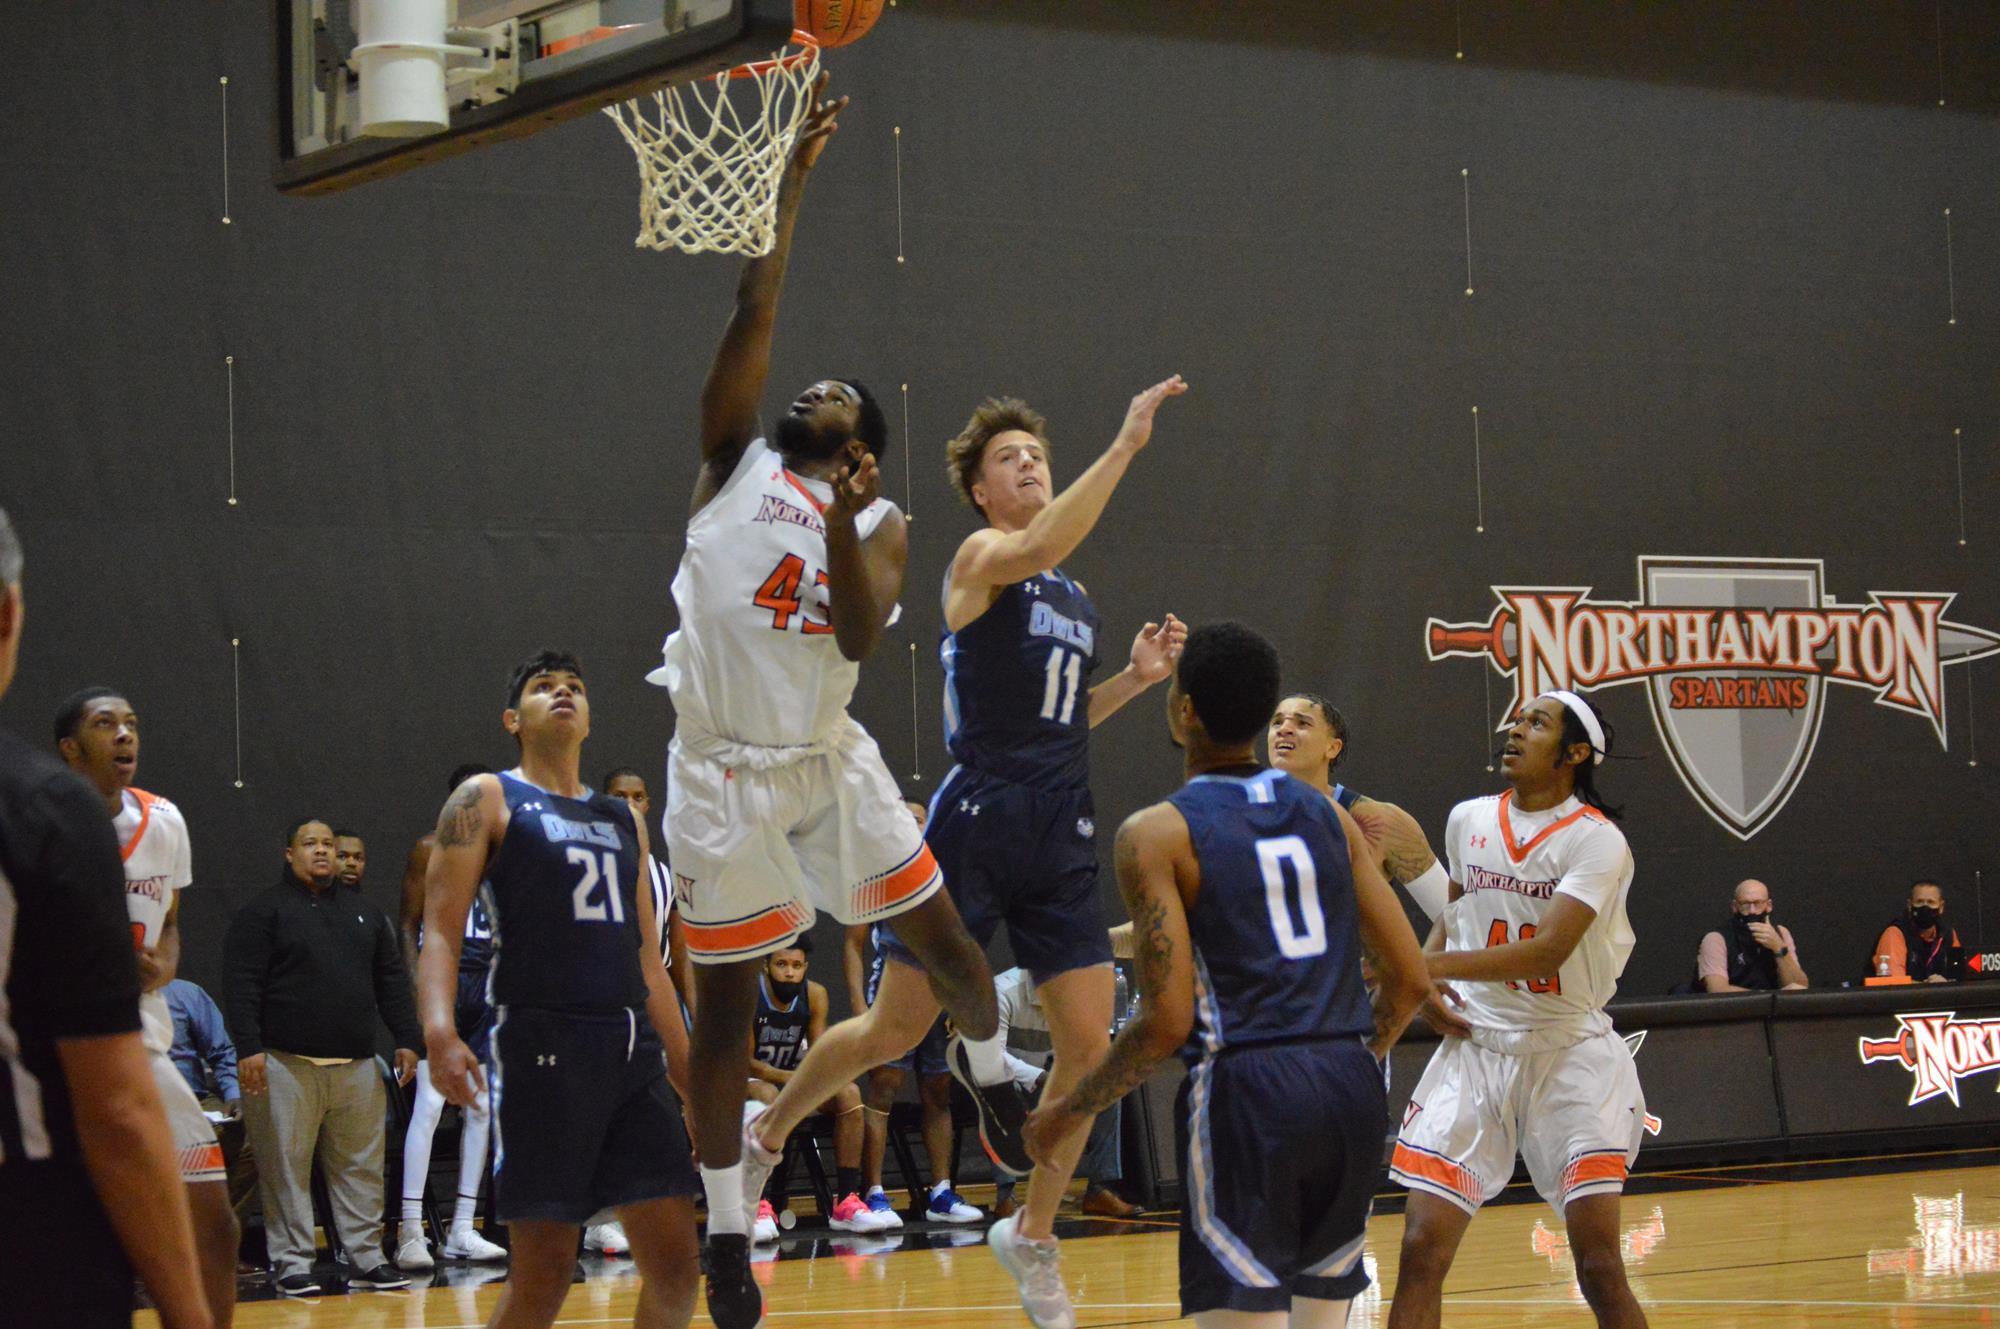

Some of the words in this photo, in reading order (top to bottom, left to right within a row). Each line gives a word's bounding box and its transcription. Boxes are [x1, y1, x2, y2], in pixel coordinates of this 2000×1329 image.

[1028, 600, 1094, 658] OWLS
[1506, 592, 1944, 720] NORTHAMPTON
[1040, 645, 1082, 725] 11
[1669, 676, 1808, 718] SPARTANS
[540, 813, 622, 850] OWLS
[566, 846, 625, 923] 21
[1255, 835, 1328, 959] 0
[1464, 864, 1561, 900] NORTHAMPTO
